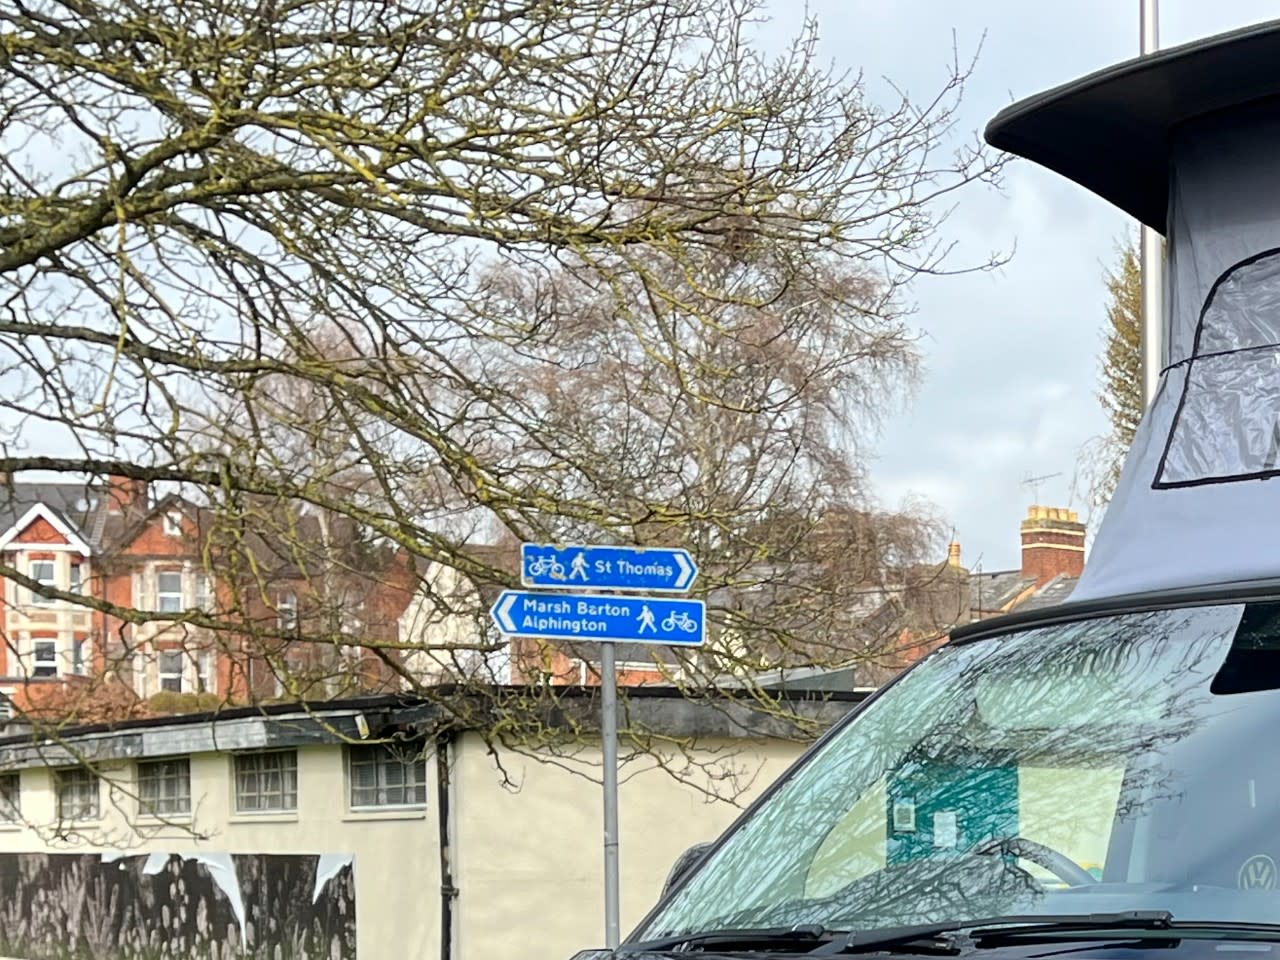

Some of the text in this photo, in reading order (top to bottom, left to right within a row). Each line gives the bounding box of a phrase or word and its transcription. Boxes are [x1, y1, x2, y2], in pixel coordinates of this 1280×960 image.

[594, 560, 674, 577] St Thomas
[523, 599, 630, 617] Marsh Barton
[522, 615, 608, 633] Alphington
